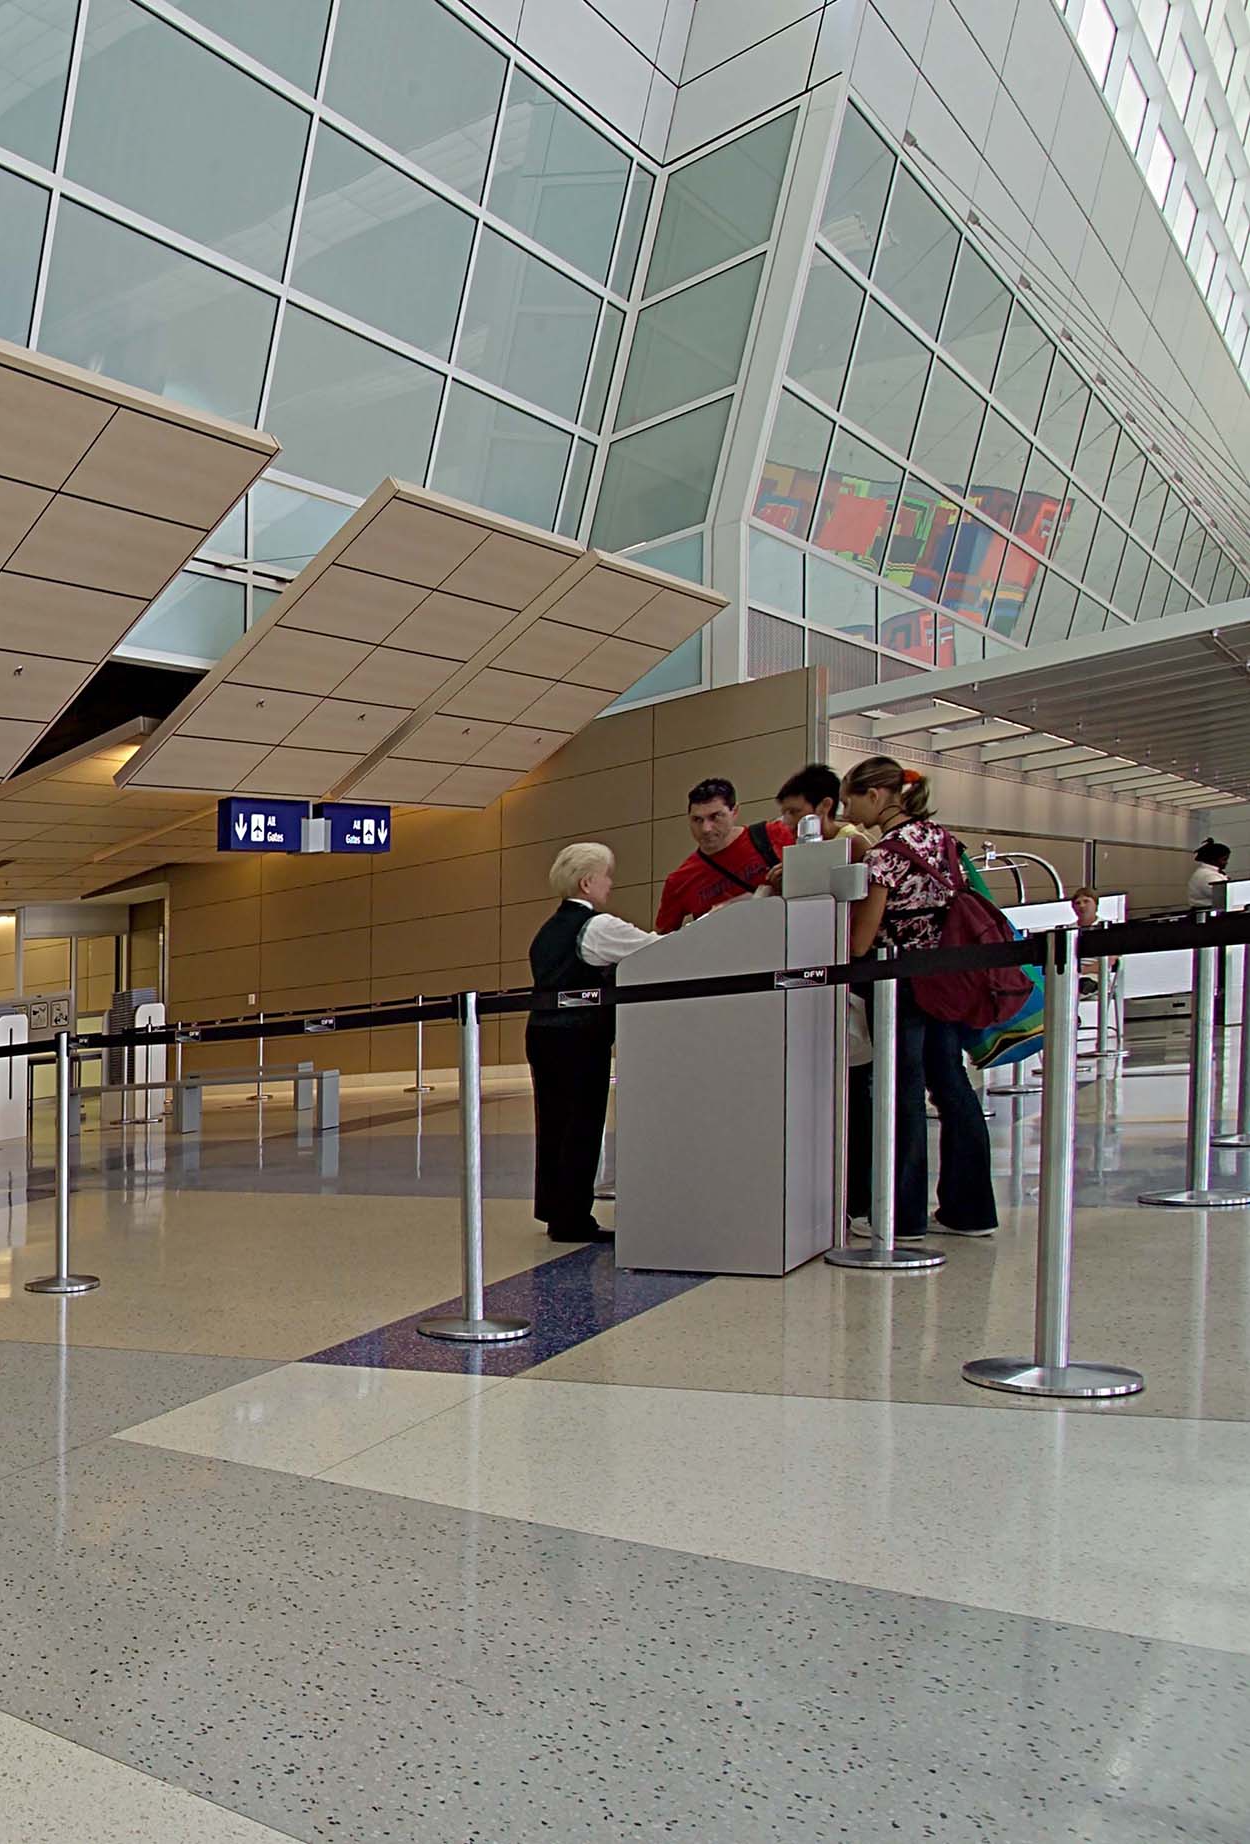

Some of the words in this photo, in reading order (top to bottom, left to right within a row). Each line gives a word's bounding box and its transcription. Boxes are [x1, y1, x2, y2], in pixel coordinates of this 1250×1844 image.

[266, 815, 276, 827] All
[352, 819, 361, 830] All
[266, 831, 284, 843] Gates
[803, 969, 824, 979] DFW
[581, 991, 599, 999] DFW
